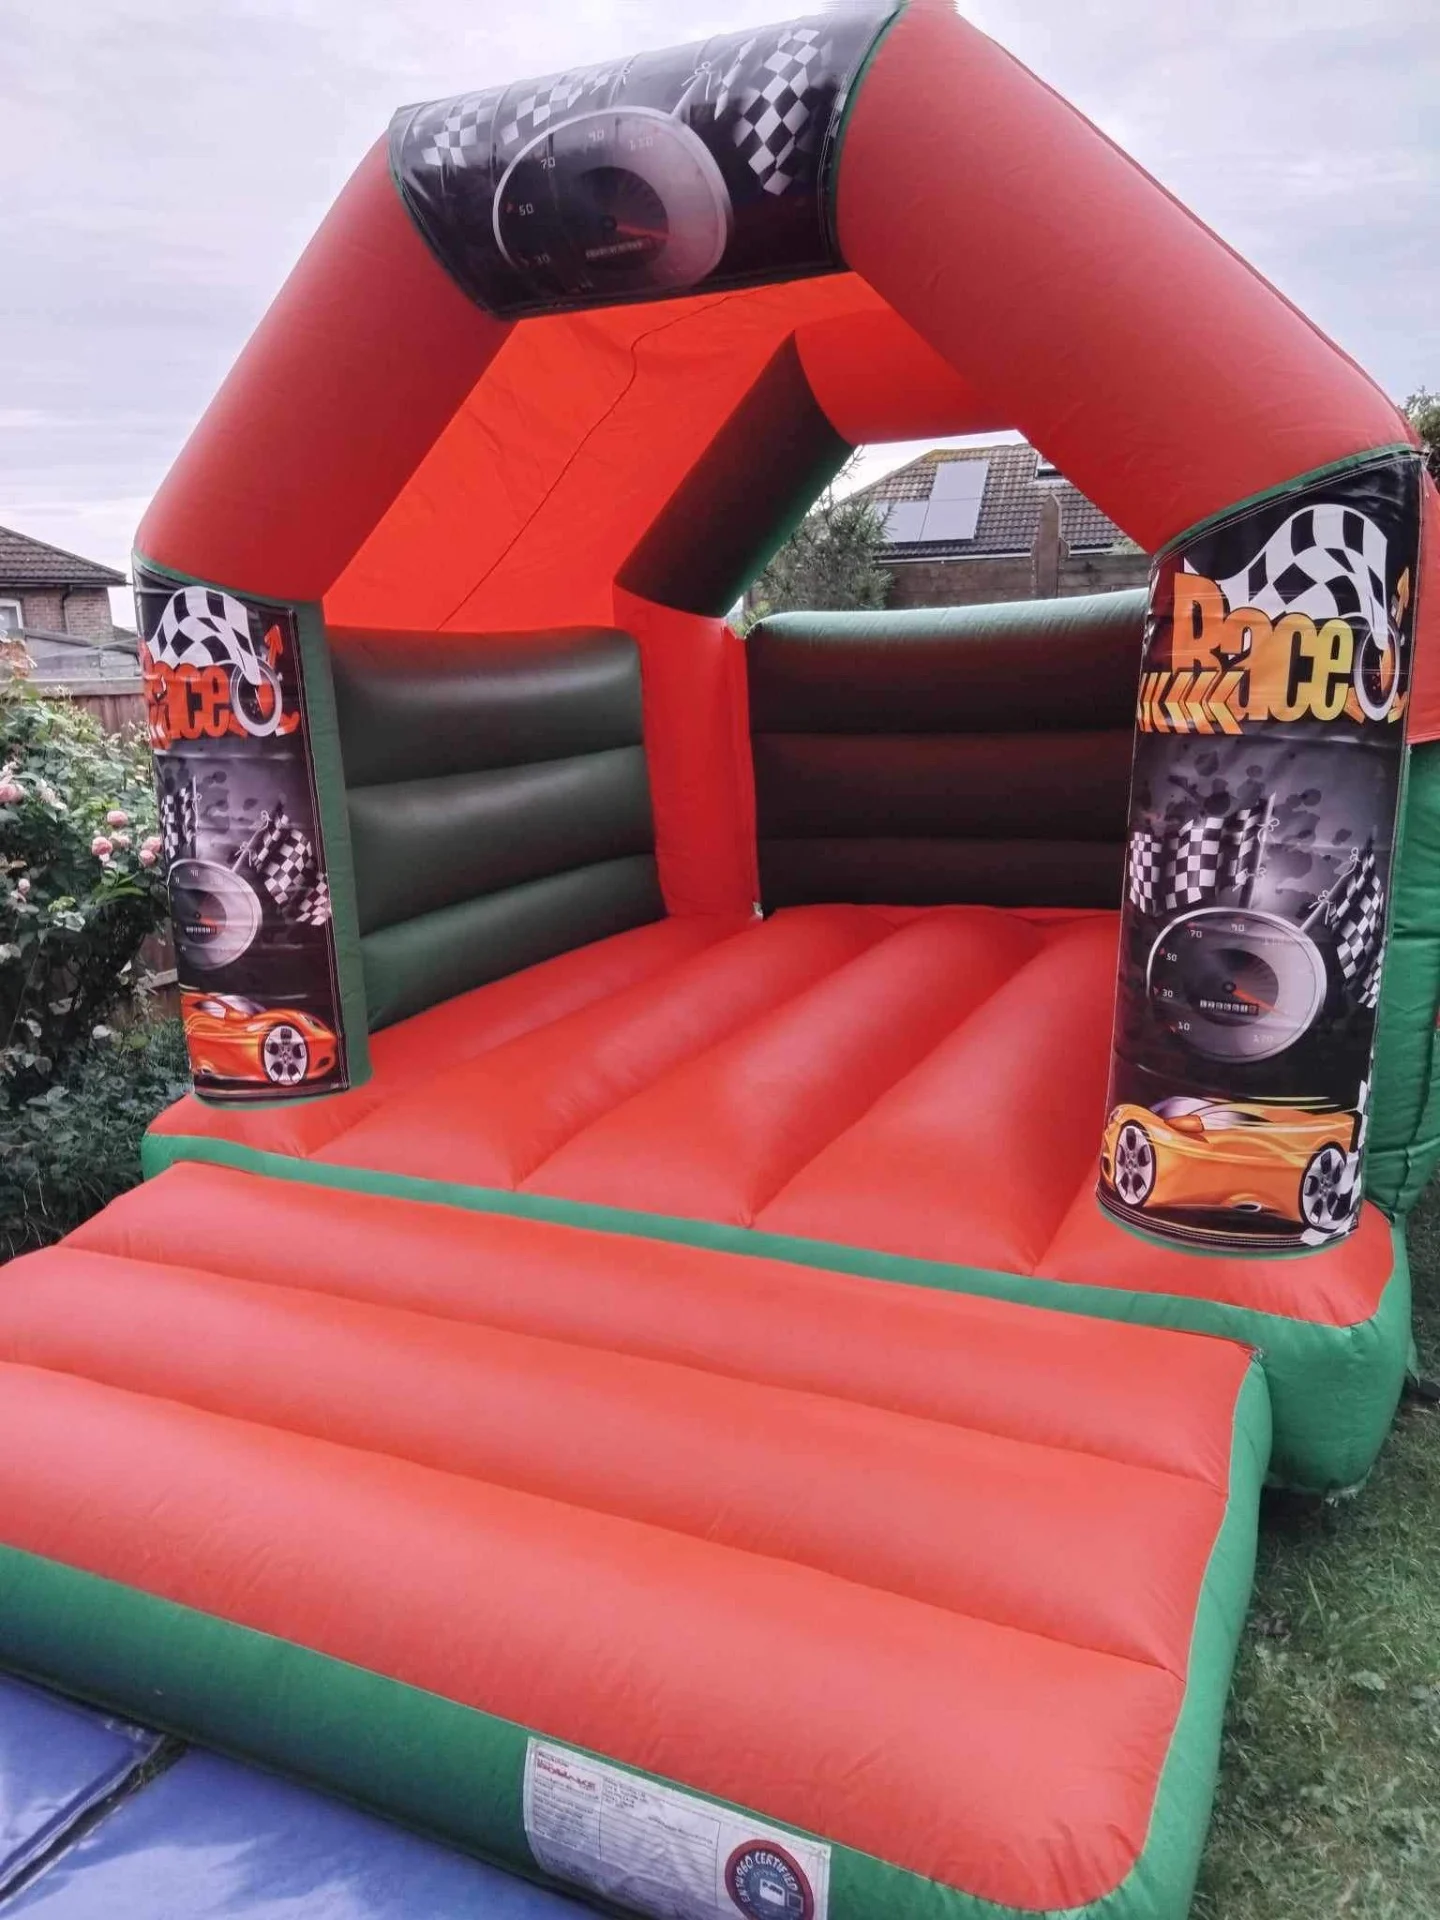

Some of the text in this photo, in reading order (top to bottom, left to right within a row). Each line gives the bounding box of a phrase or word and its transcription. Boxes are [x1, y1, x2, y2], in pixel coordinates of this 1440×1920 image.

[1172, 572, 1354, 722] Race
[1166, 952, 1178, 962] 50
[1162, 989, 1174, 998] 30
[754, 1851, 799, 1891] CERTIFIED
